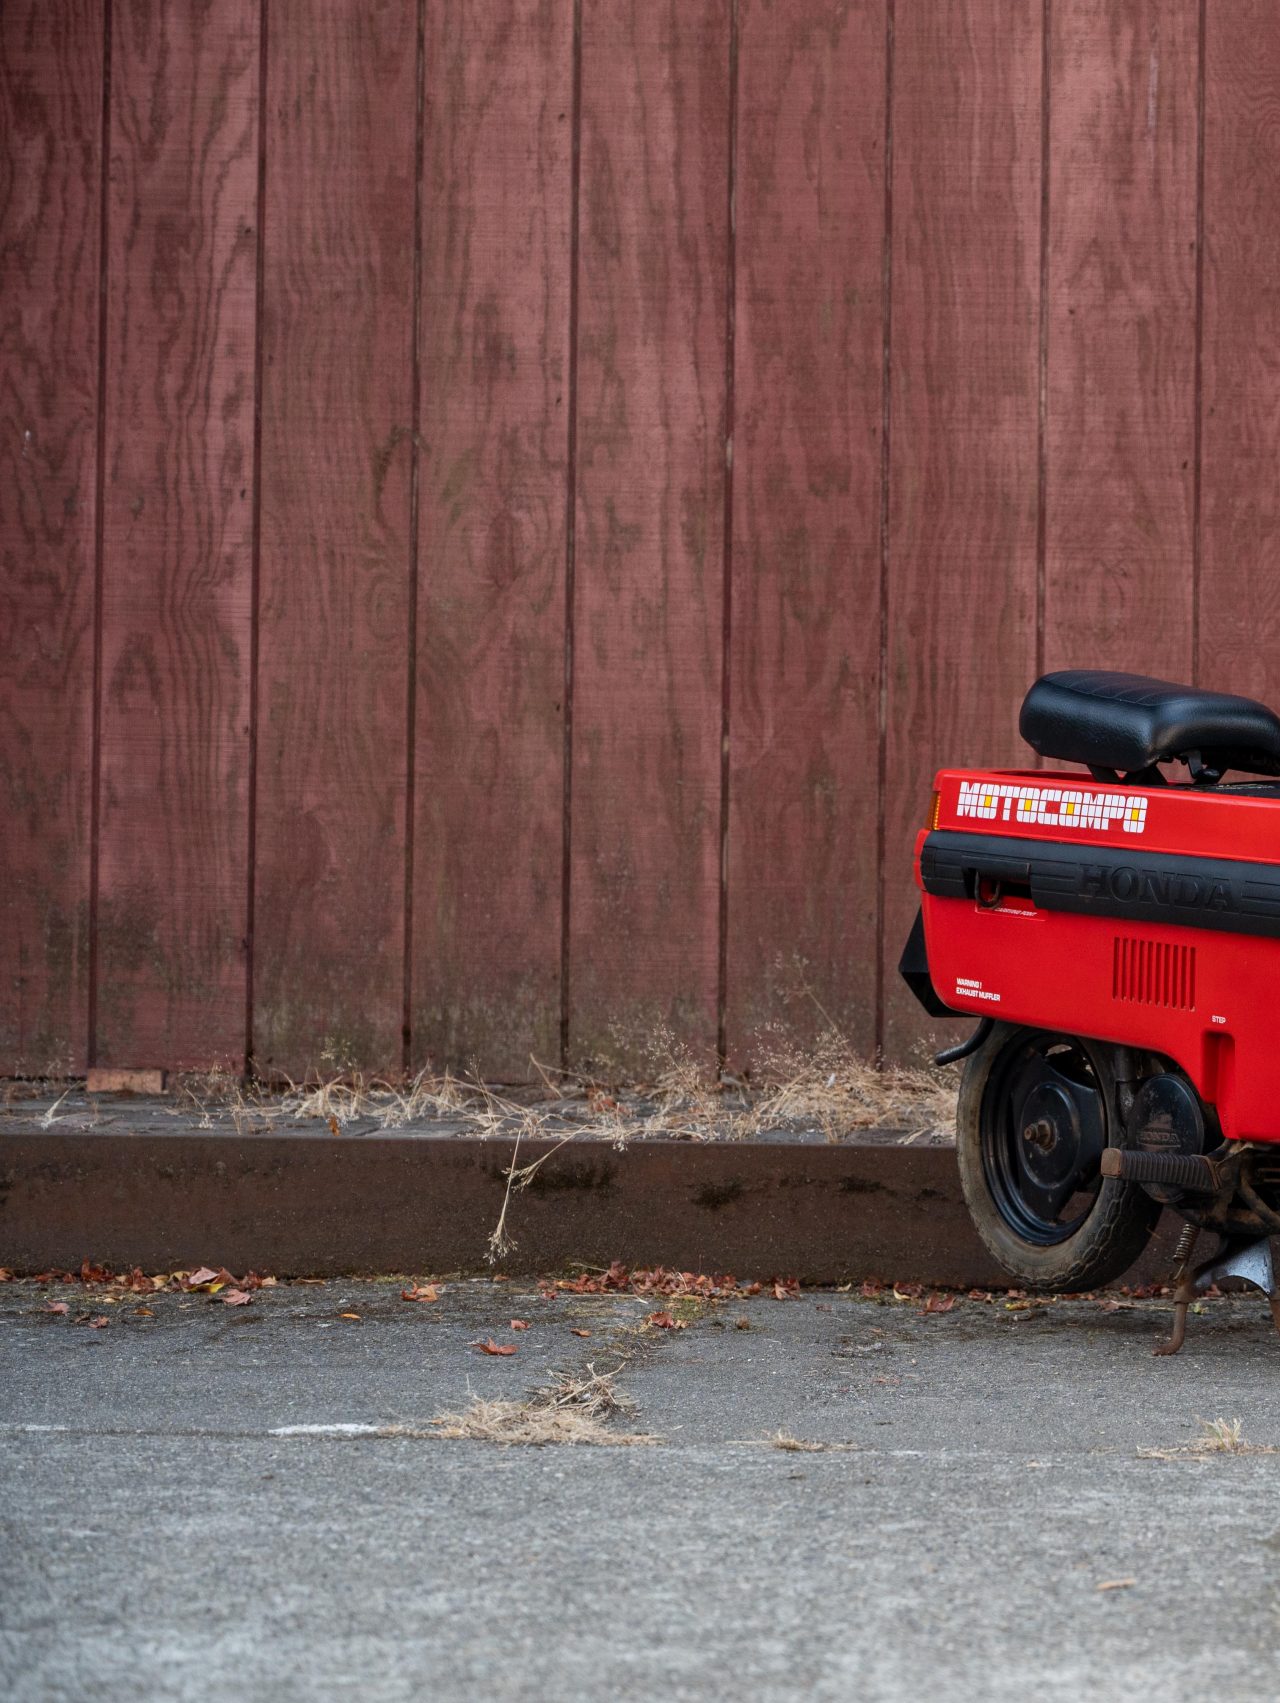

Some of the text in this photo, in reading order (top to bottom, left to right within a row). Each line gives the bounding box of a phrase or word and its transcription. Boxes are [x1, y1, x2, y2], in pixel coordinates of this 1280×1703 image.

[956, 781, 1148, 833] MOTOCOMPO
[1078, 864, 1238, 914] HONDA
[955, 986, 1001, 1002] EXHAUST MUFFLER
[1211, 1015, 1226, 1024] STEP
